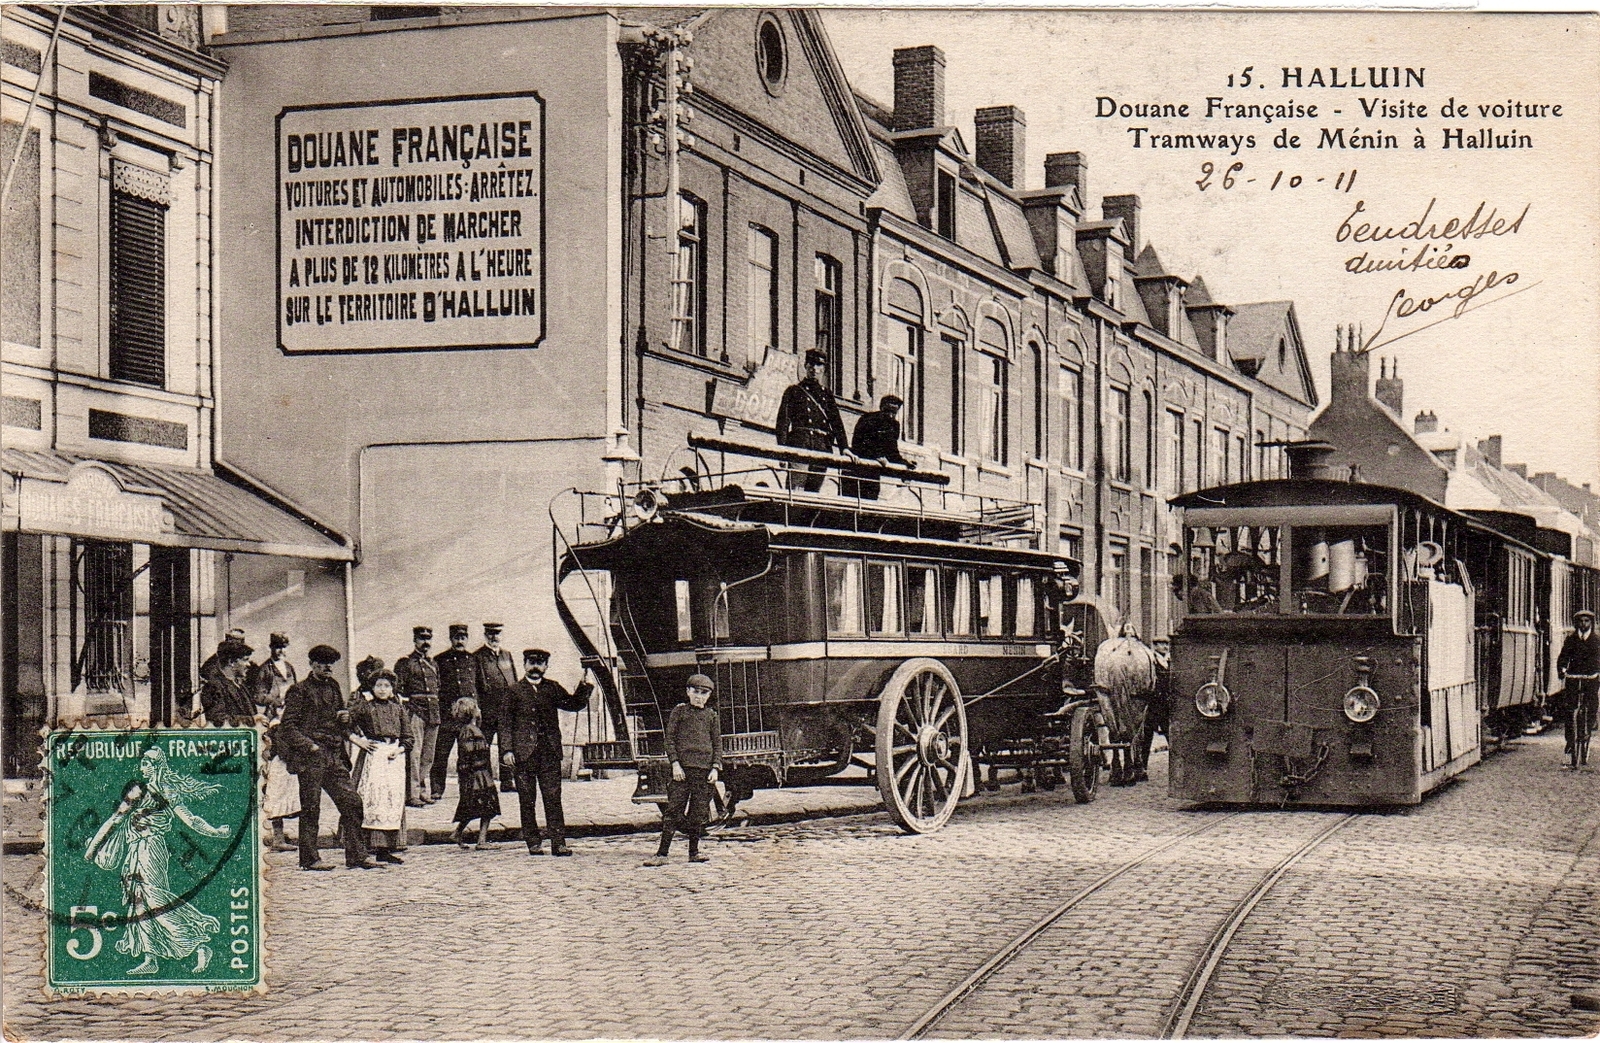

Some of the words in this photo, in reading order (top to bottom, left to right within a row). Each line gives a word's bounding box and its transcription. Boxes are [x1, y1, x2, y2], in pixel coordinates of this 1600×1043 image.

[287, 129, 380, 173] DOUANE
[392, 120, 532, 169] FRANÇAISE
[285, 179, 349, 211] VOITURES
[353, 177, 368, 208] ET
[295, 214, 410, 249] INTERDICTION
[416, 213, 436, 243] DE
[443, 209, 522, 243] MARCHER
[304, 256, 337, 287] PLUS
[343, 255, 358, 285] DE
[362, 254, 379, 284] 12
[383, 246, 450, 283] KILOMÈTRES
[286, 295, 311, 326] SUR
[316, 294, 333, 325] LE
[339, 291, 417, 325] TERRITOIRE
[423, 288, 536, 322] D'HALLUIN
[230, 886, 250, 970] POSTES
